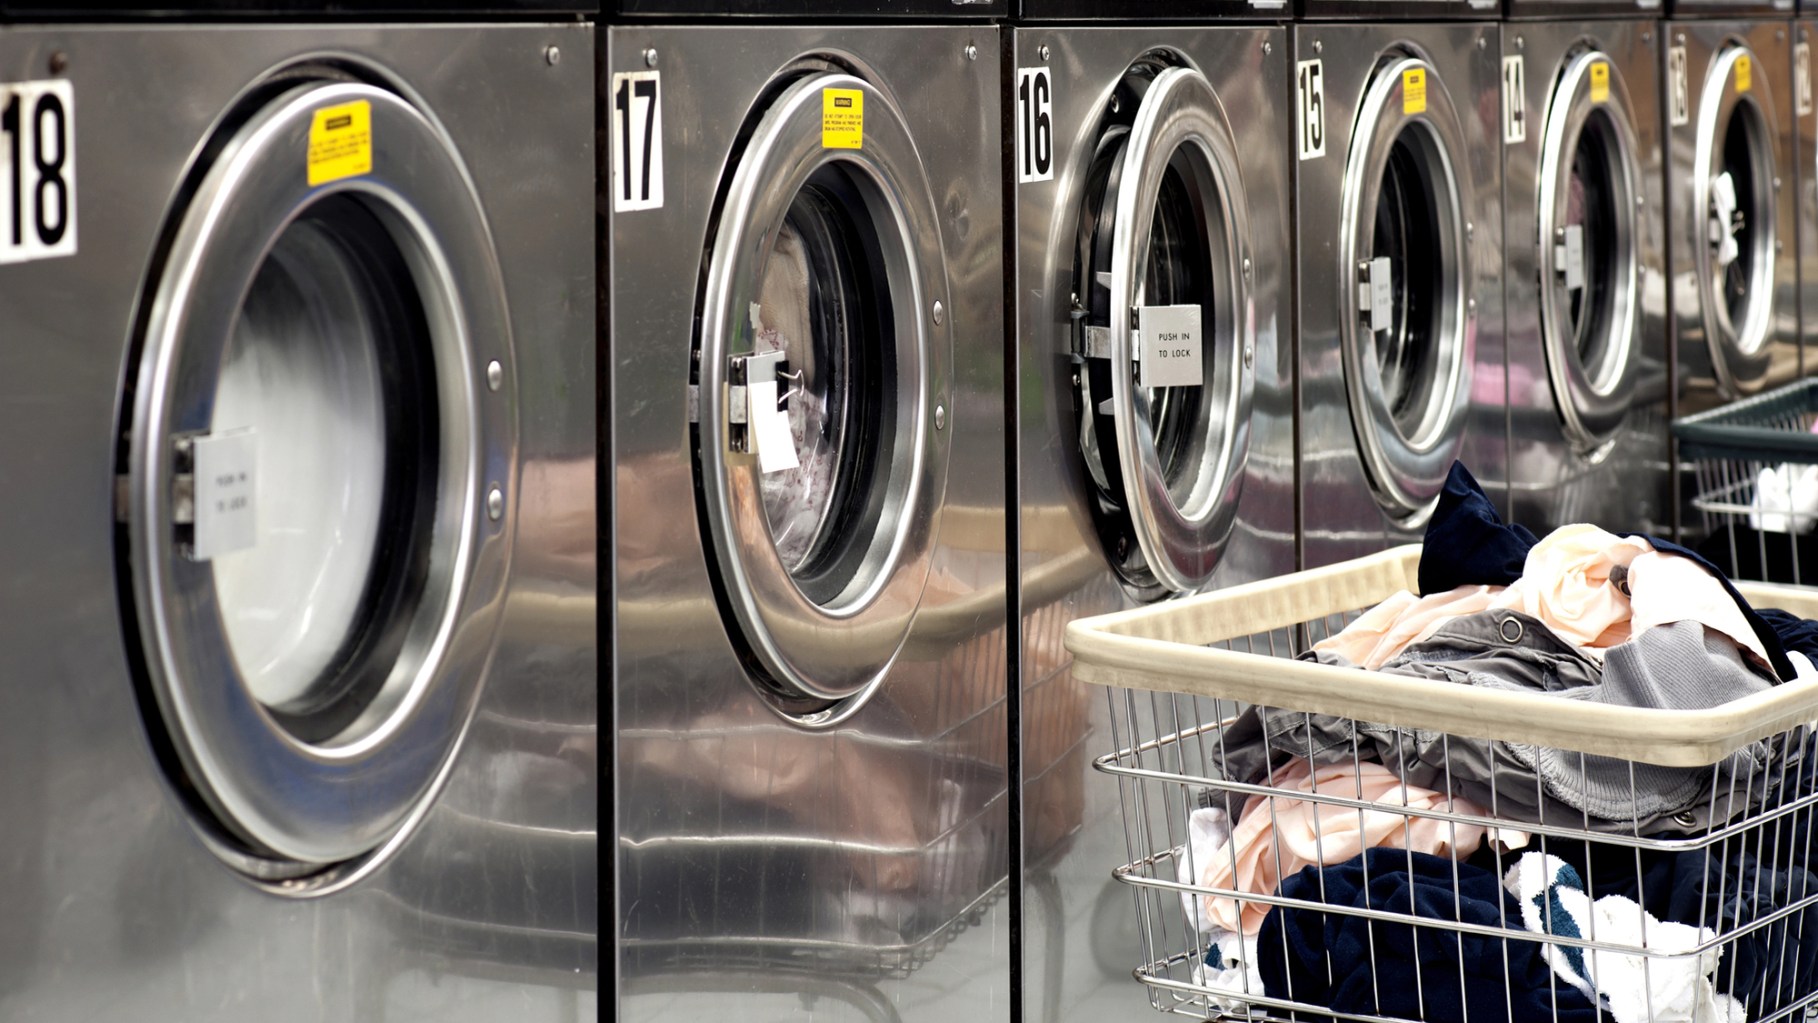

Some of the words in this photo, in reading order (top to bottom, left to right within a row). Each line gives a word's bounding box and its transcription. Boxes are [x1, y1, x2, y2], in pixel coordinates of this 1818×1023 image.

[616, 79, 657, 201] 17
[1020, 72, 1051, 176] 16
[1300, 64, 1322, 153] 15
[1506, 61, 1523, 137] 14
[3, 92, 67, 246] 18
[1158, 333, 1178, 341] PUSH
[1181, 332, 1190, 341] IN
[1158, 349, 1168, 358] TO
[1171, 349, 1191, 358] LOCK
